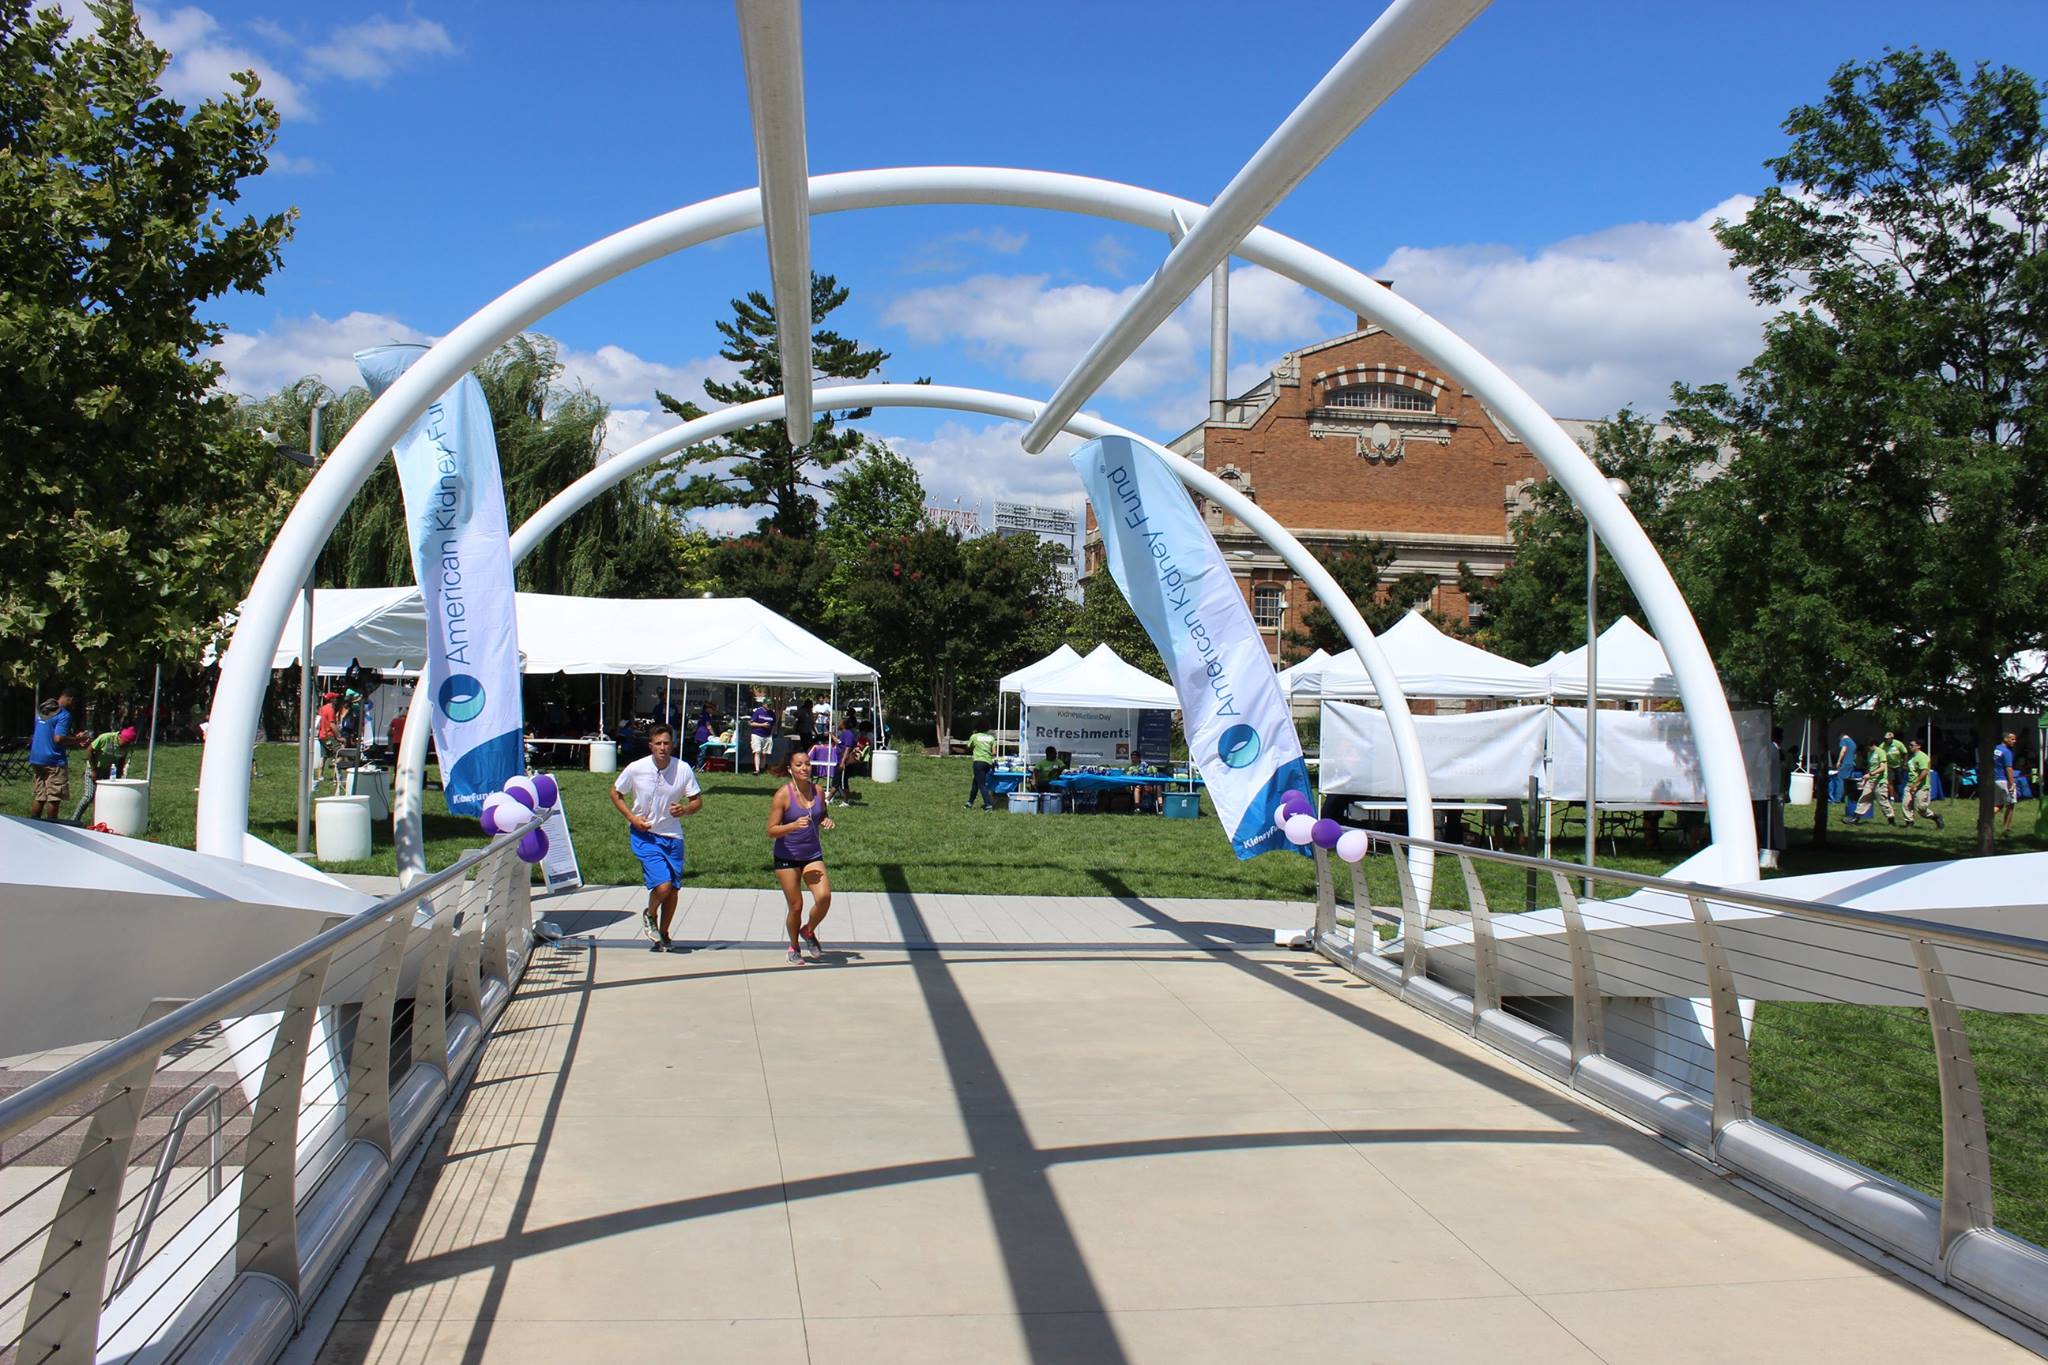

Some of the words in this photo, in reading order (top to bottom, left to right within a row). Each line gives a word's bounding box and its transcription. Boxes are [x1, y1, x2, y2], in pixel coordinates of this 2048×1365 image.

[428, 402, 447, 441] Fu
[435, 440, 457, 532] Kidney
[1107, 466, 1149, 528] Fund
[438, 540, 471, 665] American
[1142, 531, 1191, 611] Kidney
[1183, 609, 1240, 716] American
[1036, 726, 1131, 739] Refreshments
